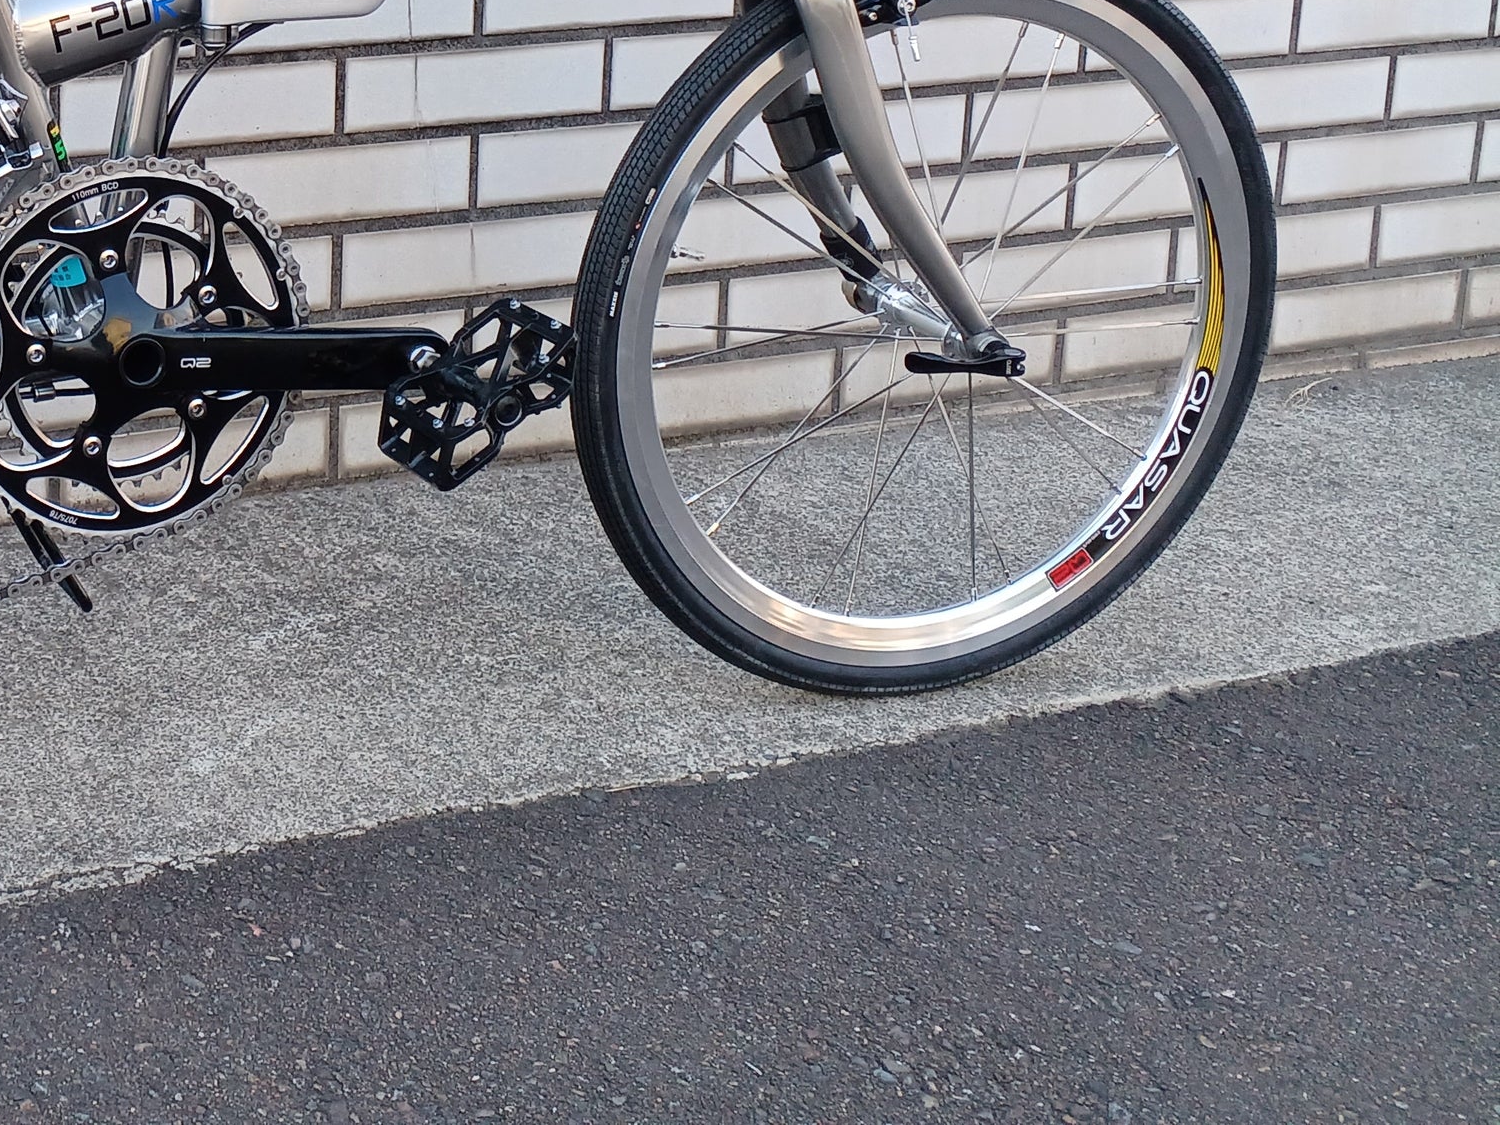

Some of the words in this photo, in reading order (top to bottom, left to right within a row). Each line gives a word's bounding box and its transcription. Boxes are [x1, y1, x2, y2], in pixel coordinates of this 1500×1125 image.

[71, 187, 99, 202] 110mm
[101, 181, 120, 195] BCD
[1101, 371, 1210, 540] QUASAR
